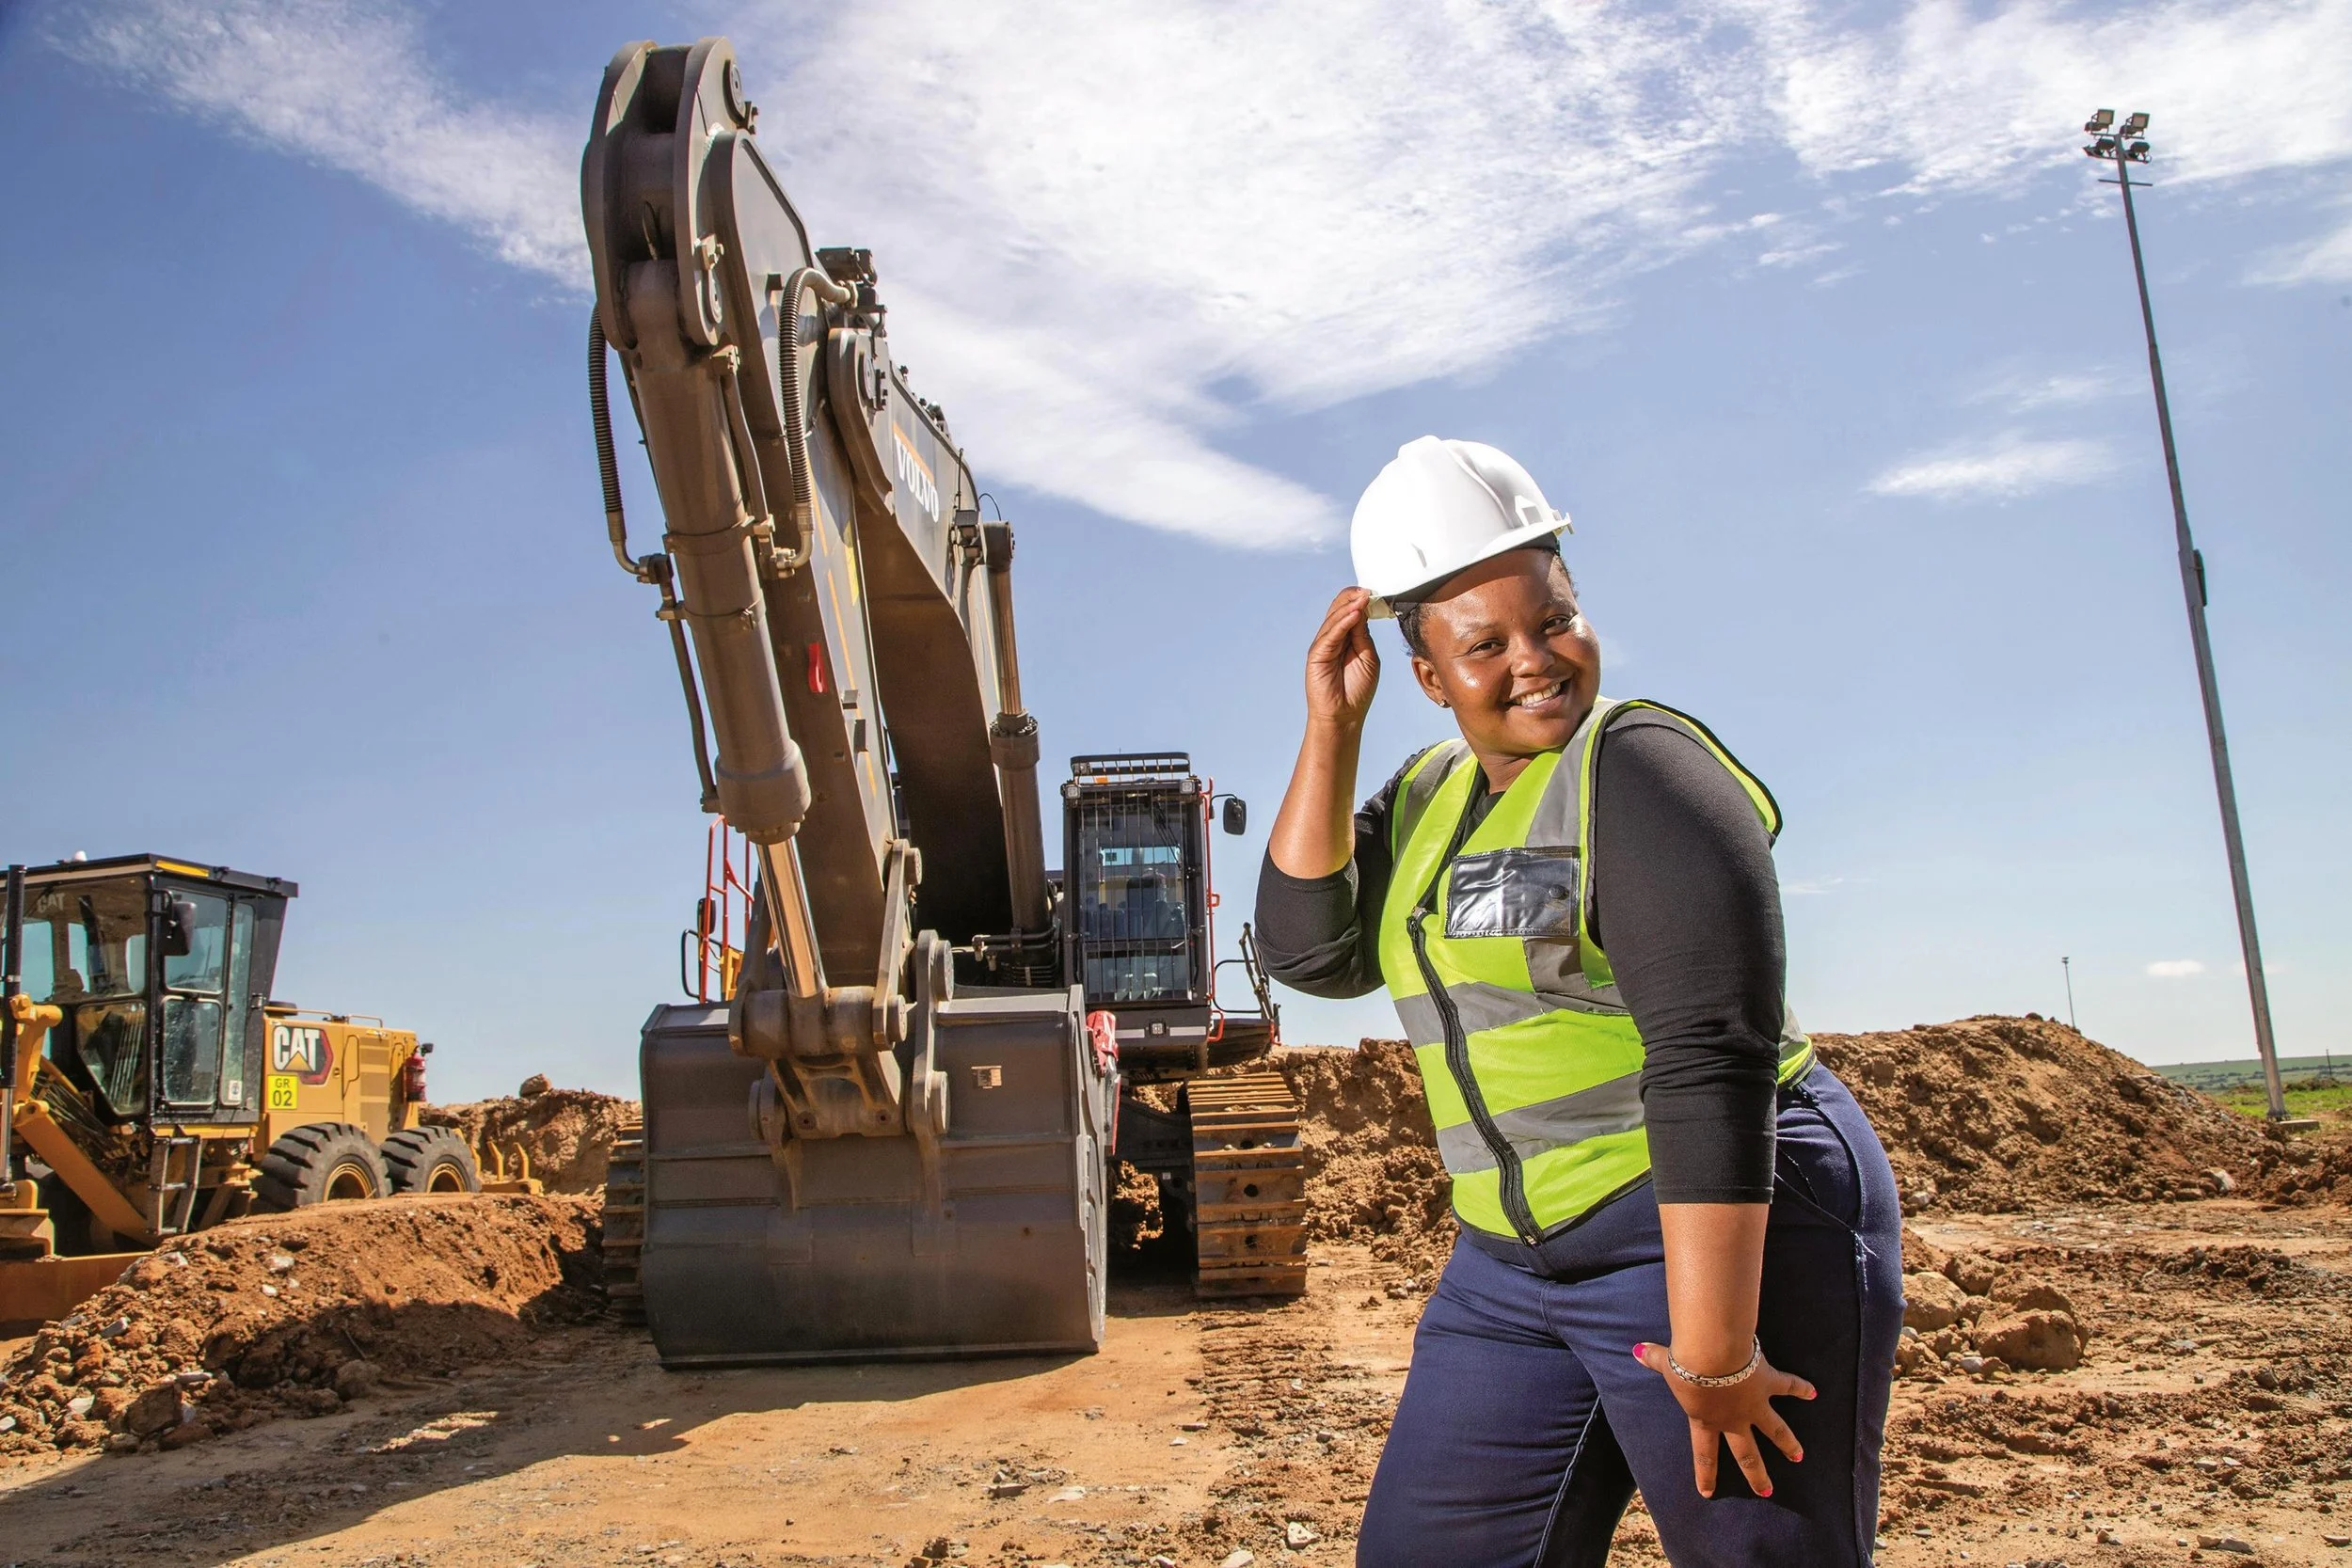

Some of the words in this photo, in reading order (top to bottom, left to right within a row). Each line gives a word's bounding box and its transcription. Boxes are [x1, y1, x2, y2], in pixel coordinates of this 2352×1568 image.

[894, 432, 939, 523] VOLVO
[37, 893, 65, 913] CAT
[273, 1025, 320, 1072] CAT
[275, 1078, 291, 1088] GR
[273, 1090, 293, 1106] 02
